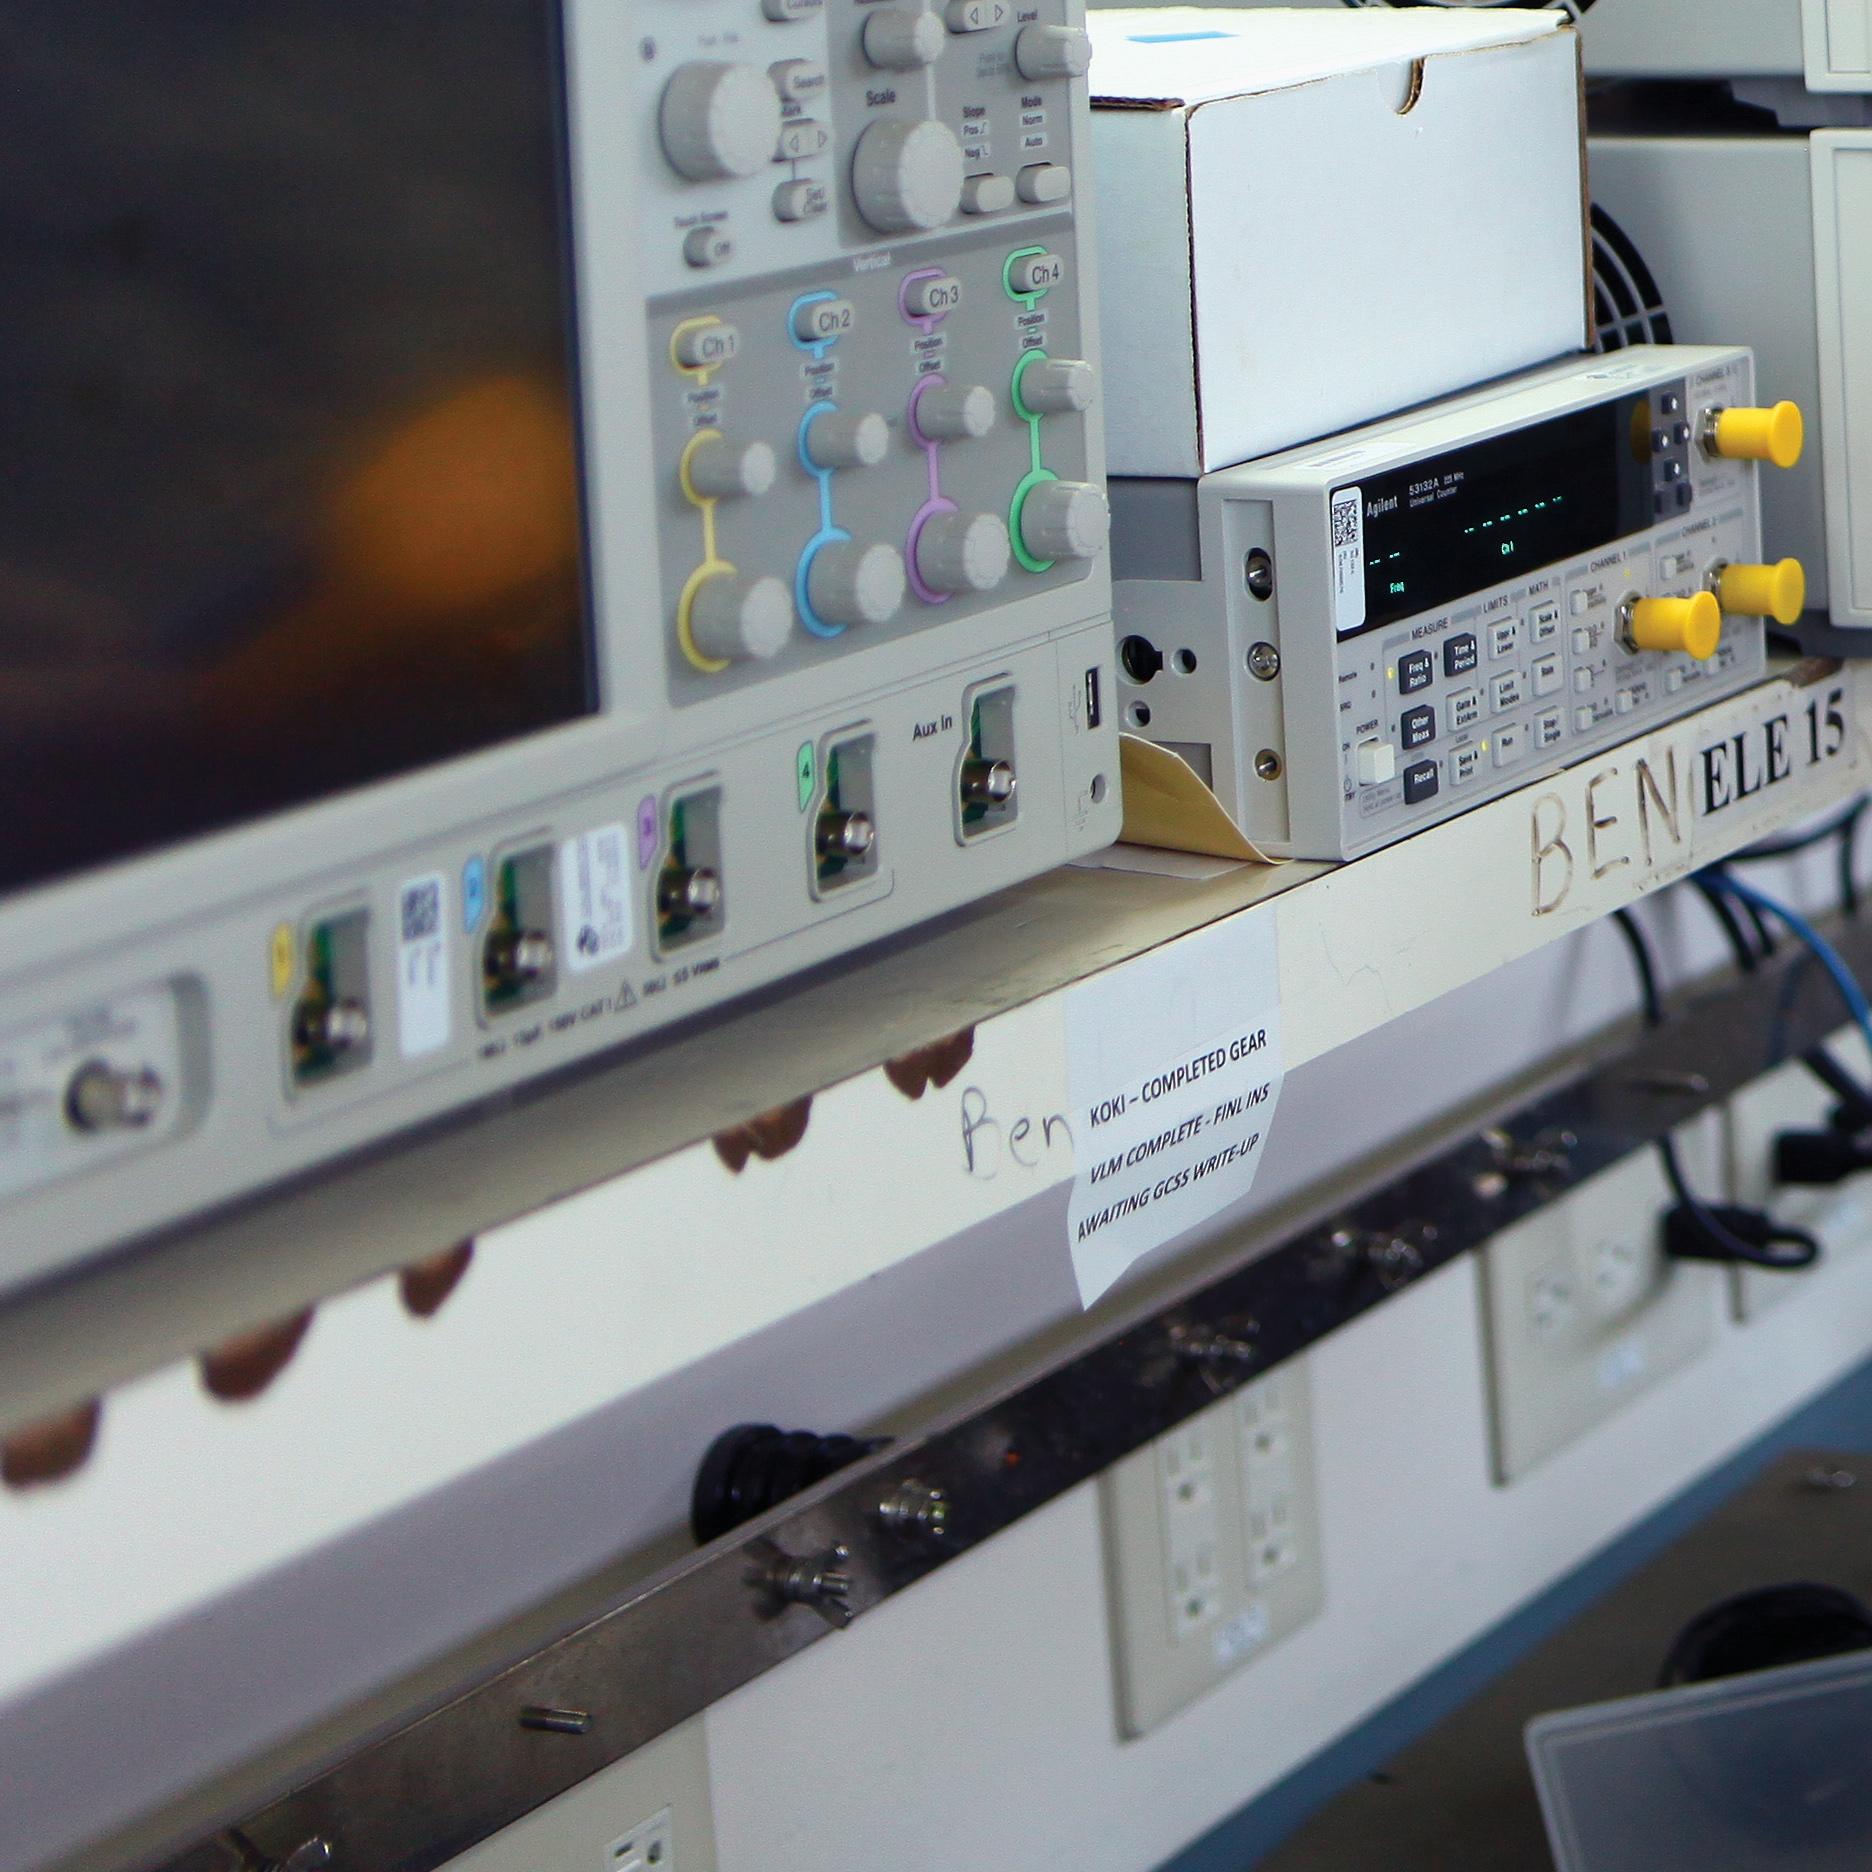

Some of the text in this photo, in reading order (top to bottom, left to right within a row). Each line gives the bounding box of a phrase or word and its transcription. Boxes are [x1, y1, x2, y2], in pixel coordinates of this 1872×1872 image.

[1017, 10, 1038, 22] Level
[866, 88, 896, 107] Scale
[1025, 136, 1043, 147] Auto
[1032, 263, 1059, 285] Ch 4
[929, 285, 959, 308] Ch 3
[819, 309, 850, 331] Ch 2
[1017, 313, 1045, 327] Position
[702, 336, 724, 357] Ch
[914, 336, 943, 352] Position
[1022, 336, 1043, 350] Offset
[919, 359, 941, 374] Offset
[1408, 477, 1439, 496] 53132A
[1366, 495, 1398, 518] Agilent
[1590, 554, 1621, 572] CHANNEL
[1528, 579, 1549, 595] MATH
[1483, 594, 1508, 614] LIMITS
[1411, 617, 1448, 640] MEASURE
[1409, 661, 1424, 675] Freq
[1454, 654, 1475, 670] Period
[1409, 674, 1427, 687] Ratio
[912, 714, 953, 742] Aux In
[1356, 719, 1378, 735] POWER
[1700, 688, 1847, 817] ELE 15
[802, 762, 810, 779] 4
[1414, 768, 1434, 783] Recall
[1531, 745, 1682, 917] BEN
[1090, 1093, 1126, 1128] KOKI
[1141, 1048, 1226, 1104] COMPLETED
[1229, 1028, 1268, 1061] GEAR
[961, 1086, 1076, 1180] Ben
[1090, 1153, 1122, 1185] VLM
[1126, 1114, 1204, 1168] COMPLETE
[1213, 1096, 1242, 1127] FINL
[1245, 1082, 1270, 1110] INS
[1078, 1132, 1260, 1244] AWAITING GCSS WRITE-UP
